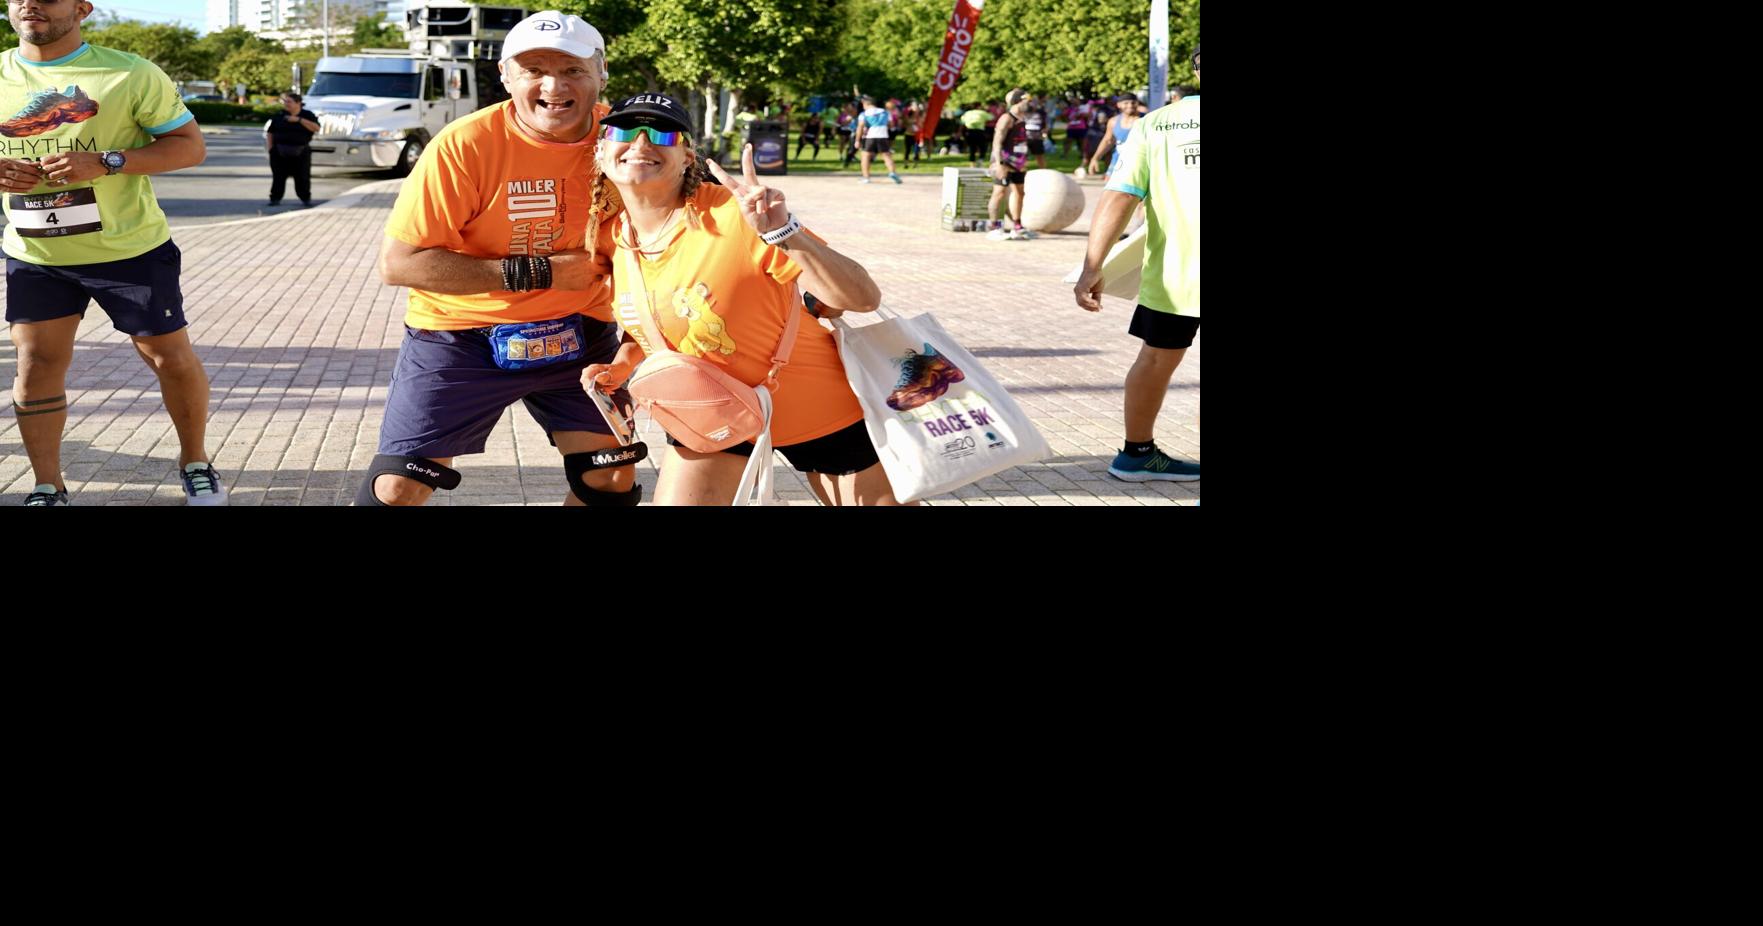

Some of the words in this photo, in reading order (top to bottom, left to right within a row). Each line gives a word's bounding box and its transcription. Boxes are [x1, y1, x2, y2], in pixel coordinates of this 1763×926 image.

[936, 28, 972, 91] Claro
[624, 95, 672, 109] FELIZ
[507, 179, 555, 194] MILER
[24, 200, 43, 209] RACE
[44, 198, 55, 208] 5K
[507, 194, 557, 222] 10
[46, 212, 59, 225] 4
[924, 413, 972, 437] RACE
[968, 406, 995, 427] 5K
[597, 450, 637, 465] Mueller
